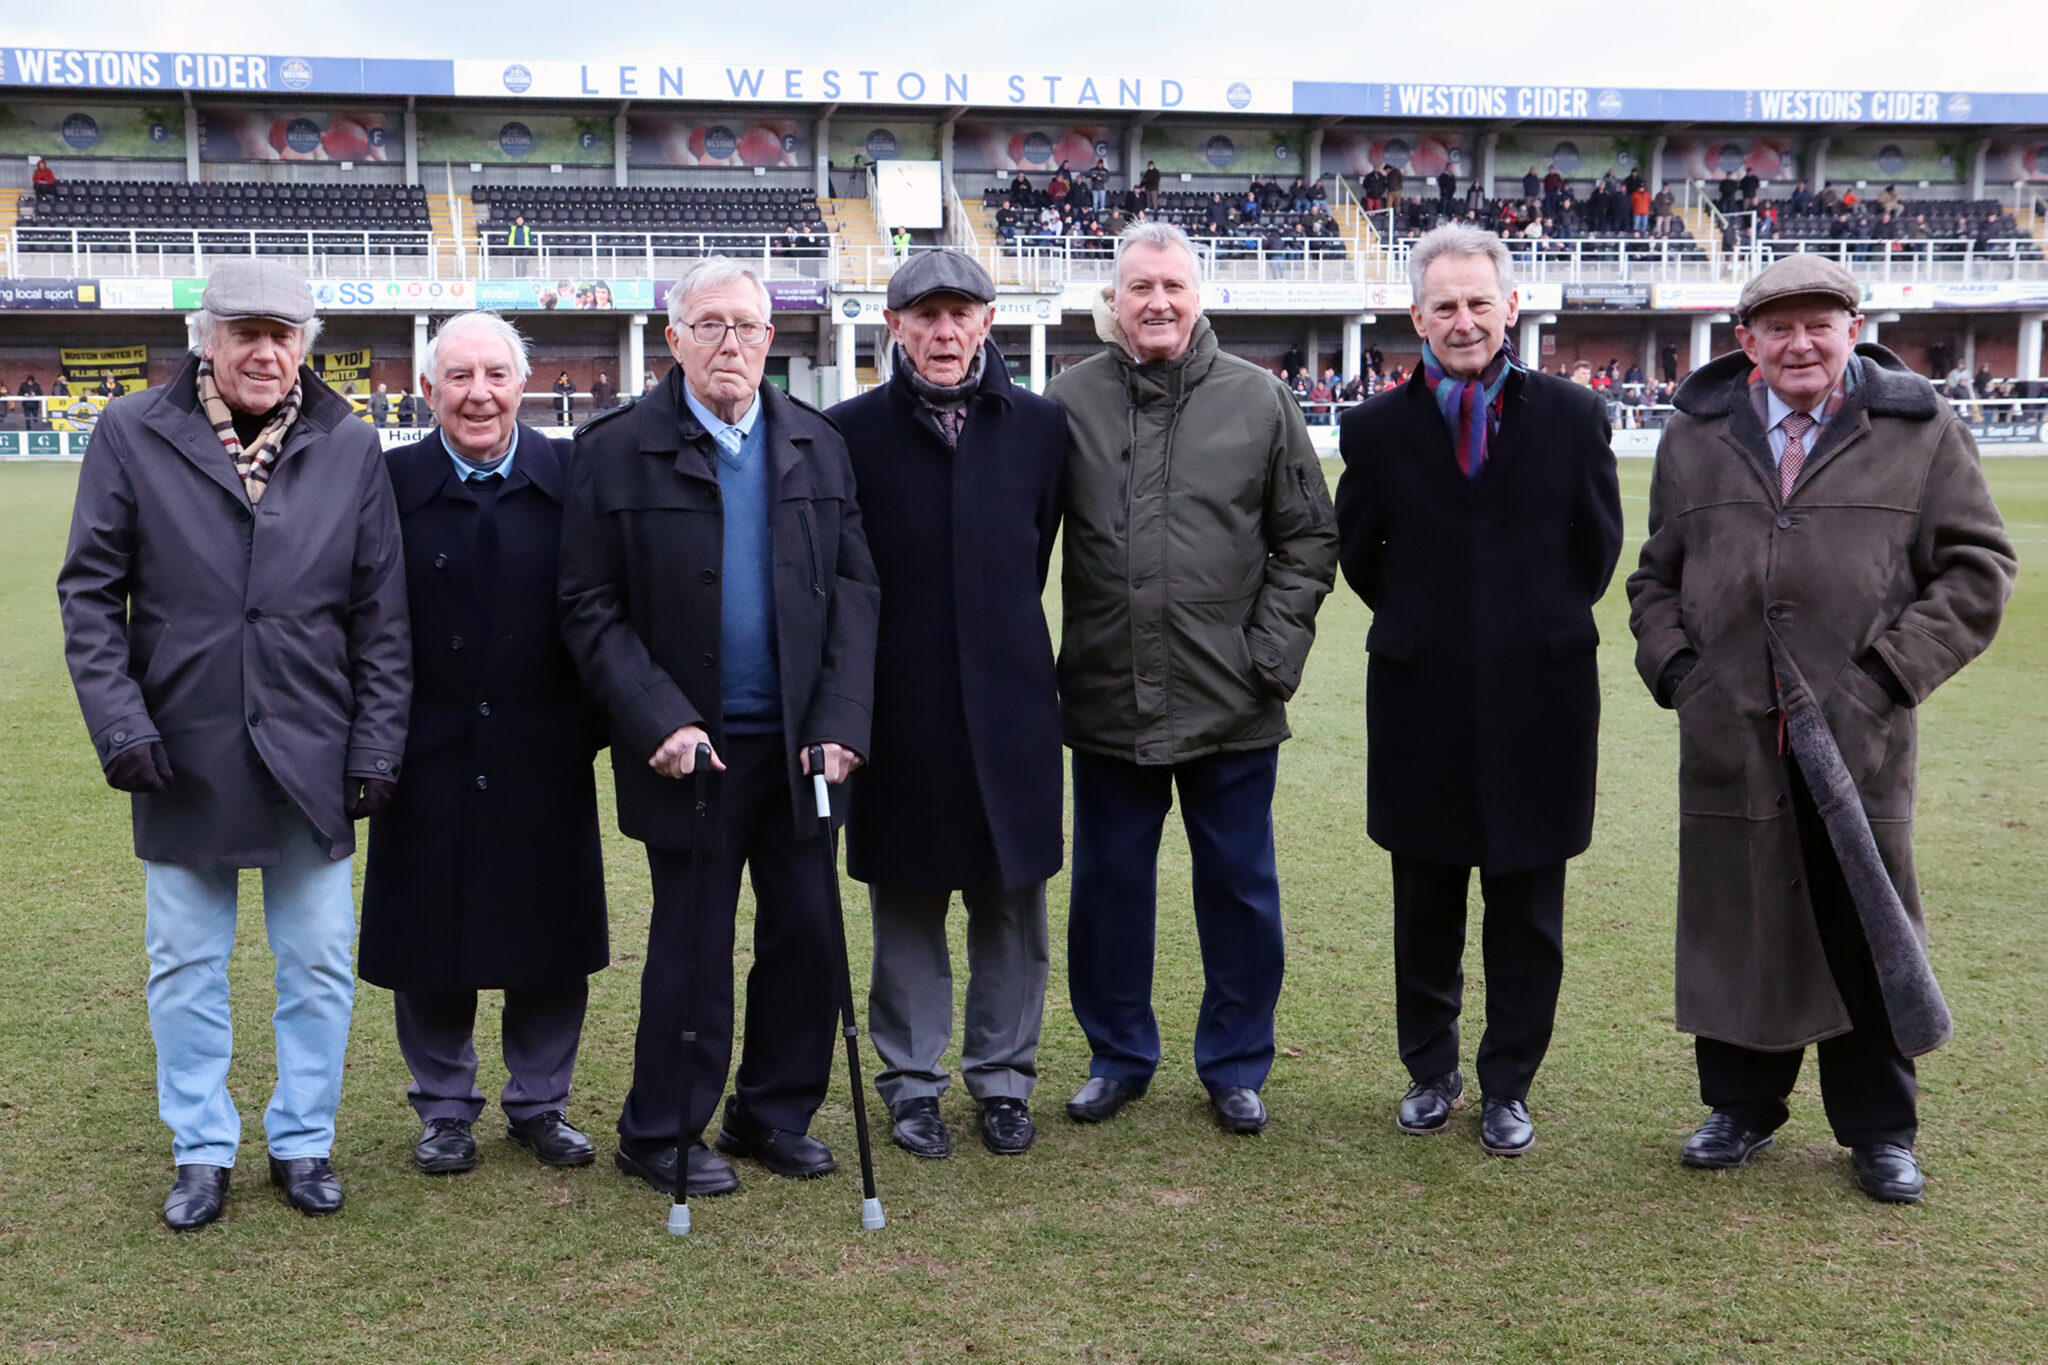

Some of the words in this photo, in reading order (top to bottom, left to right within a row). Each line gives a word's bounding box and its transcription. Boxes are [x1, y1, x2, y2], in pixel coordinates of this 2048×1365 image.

[15, 49, 161, 87] WESTONS
[174, 54, 268, 89] CIDER
[580, 65, 684, 97] LEN
[725, 68, 969, 103] WESTON
[1007, 74, 1184, 107] STAND
[1398, 85, 1507, 116] WESTONS
[1517, 87, 1588, 117] CIDER
[1759, 90, 1863, 120] WESTONS
[1871, 92, 1940, 121] CIDER
[15, 288, 42, 300] local
[44, 289, 74, 301] sport
[64, 352, 98, 360] BOSTON
[100, 350, 131, 359] UNITED
[133, 349, 144, 358] FC
[323, 369, 359, 382] UNITED
